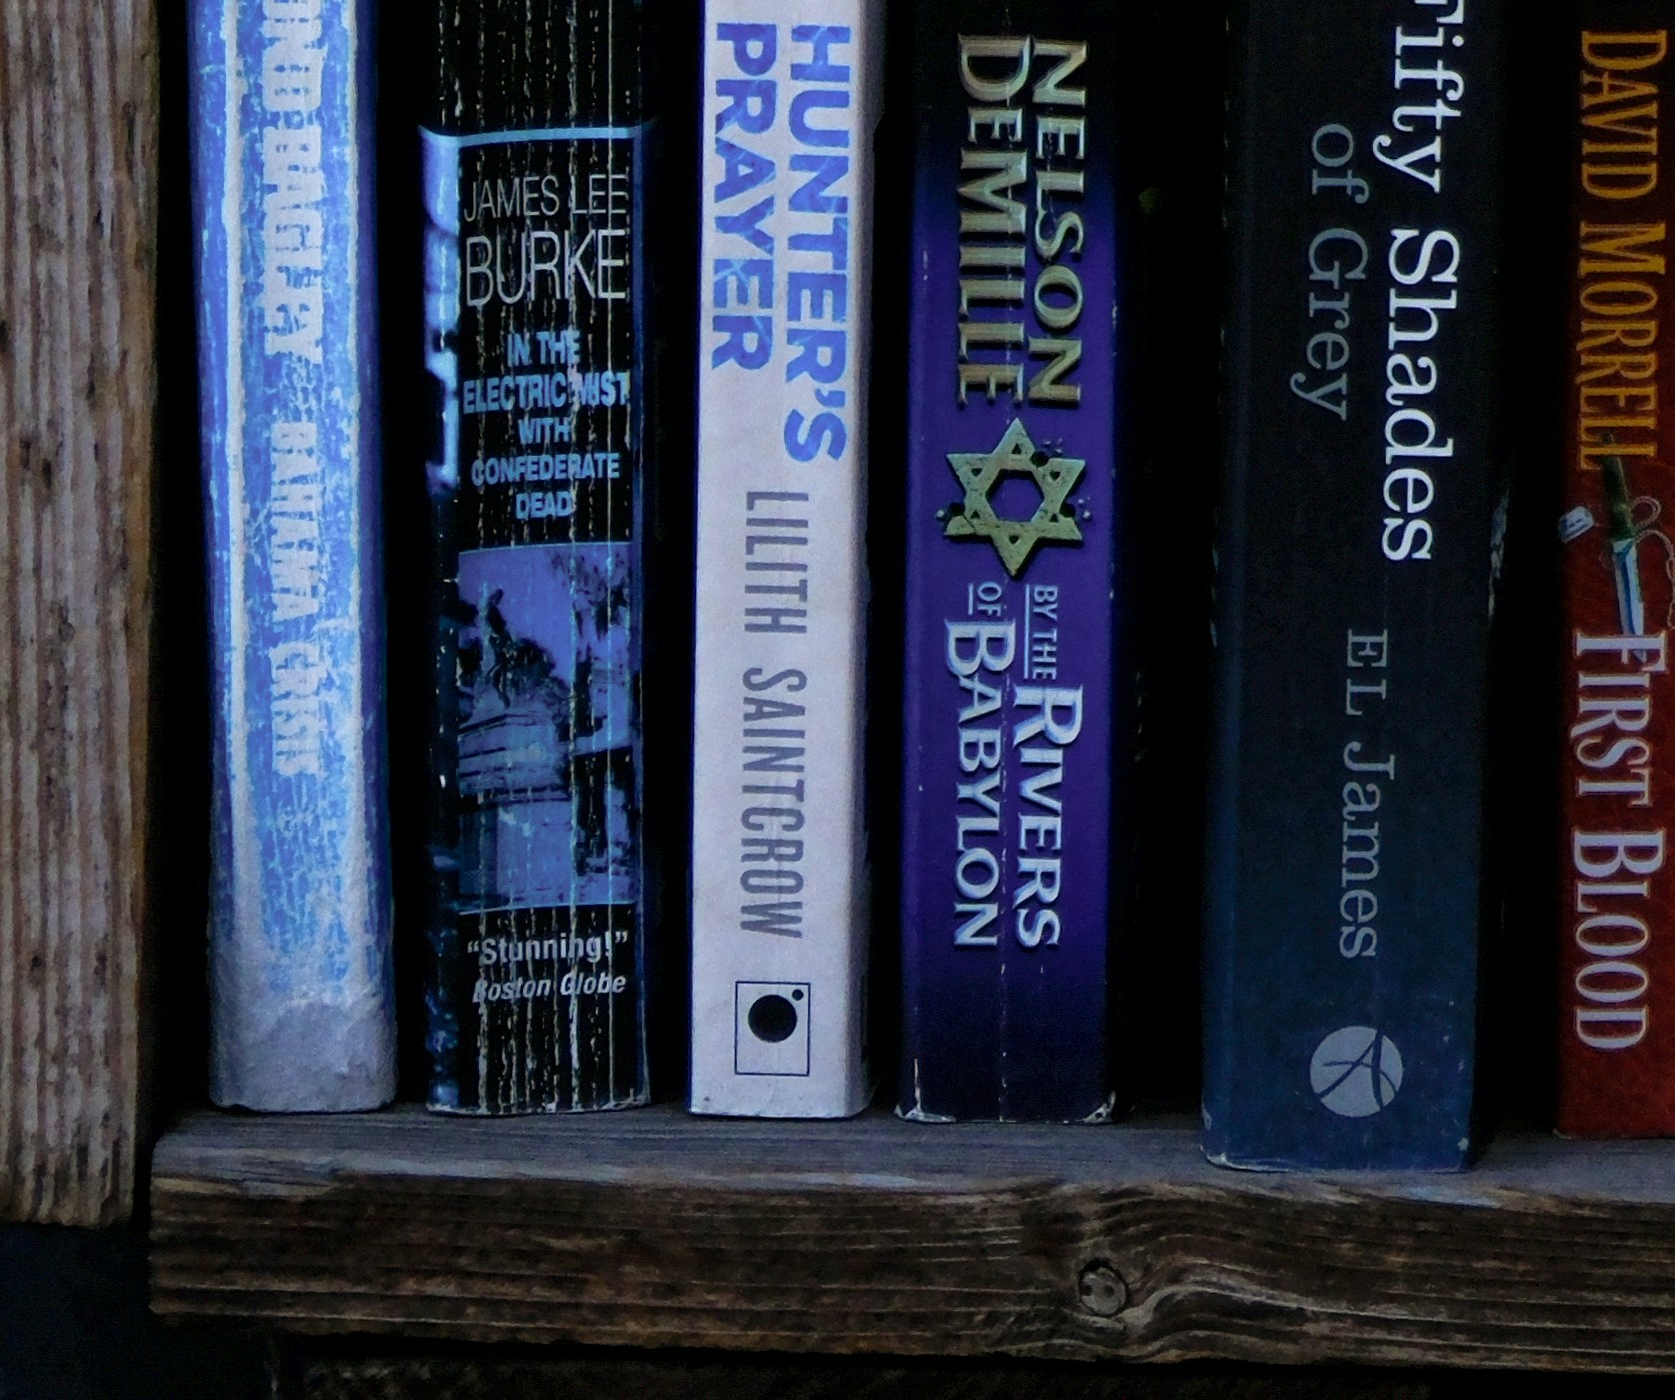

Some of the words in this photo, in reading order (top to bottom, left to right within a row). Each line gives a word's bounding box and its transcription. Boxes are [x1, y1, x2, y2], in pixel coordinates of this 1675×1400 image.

[463, 175, 561, 223] JAMES
[568, 173, 628, 217] LEE
[710, 21, 779, 370] PRAYER
[956, 31, 1034, 411] DEMILLE
[1310, 122, 1370, 204] of
[1578, 28, 1669, 200] DAVID
[464, 228, 628, 307] BURKE
[1289, 226, 1369, 421] Grey
[1574, 220, 1668, 472] MORRELL
[1379, 226, 1462, 562] Shades
[743, 490, 810, 634] LILITH
[736, 666, 808, 940] SAINTCROW
[944, 617, 1018, 948] BABYLON
[1567, 629, 1669, 808] FIRST
[1339, 741, 1396, 959] James
[1572, 826, 1666, 1052] BLOOD
